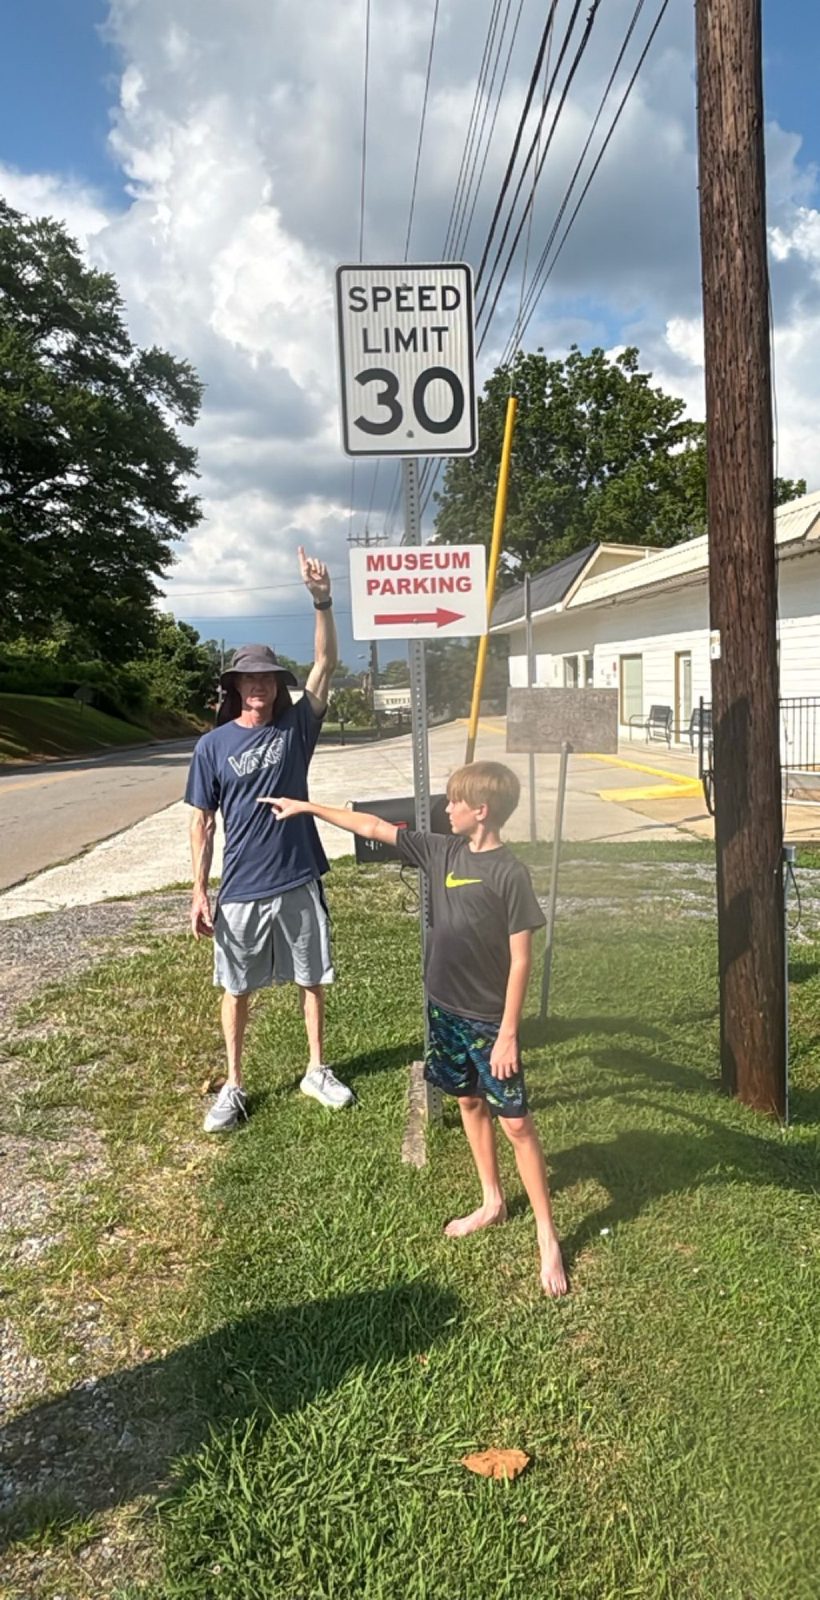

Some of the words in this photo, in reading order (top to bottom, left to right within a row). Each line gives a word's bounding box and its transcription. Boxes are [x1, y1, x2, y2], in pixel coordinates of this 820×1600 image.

[348, 285, 461, 313] SPEED
[362, 326, 449, 354] LIMIT
[353, 366, 465, 436] 30
[366, 551, 471, 572] MUSEUM
[366, 576, 473, 596] PARKING
